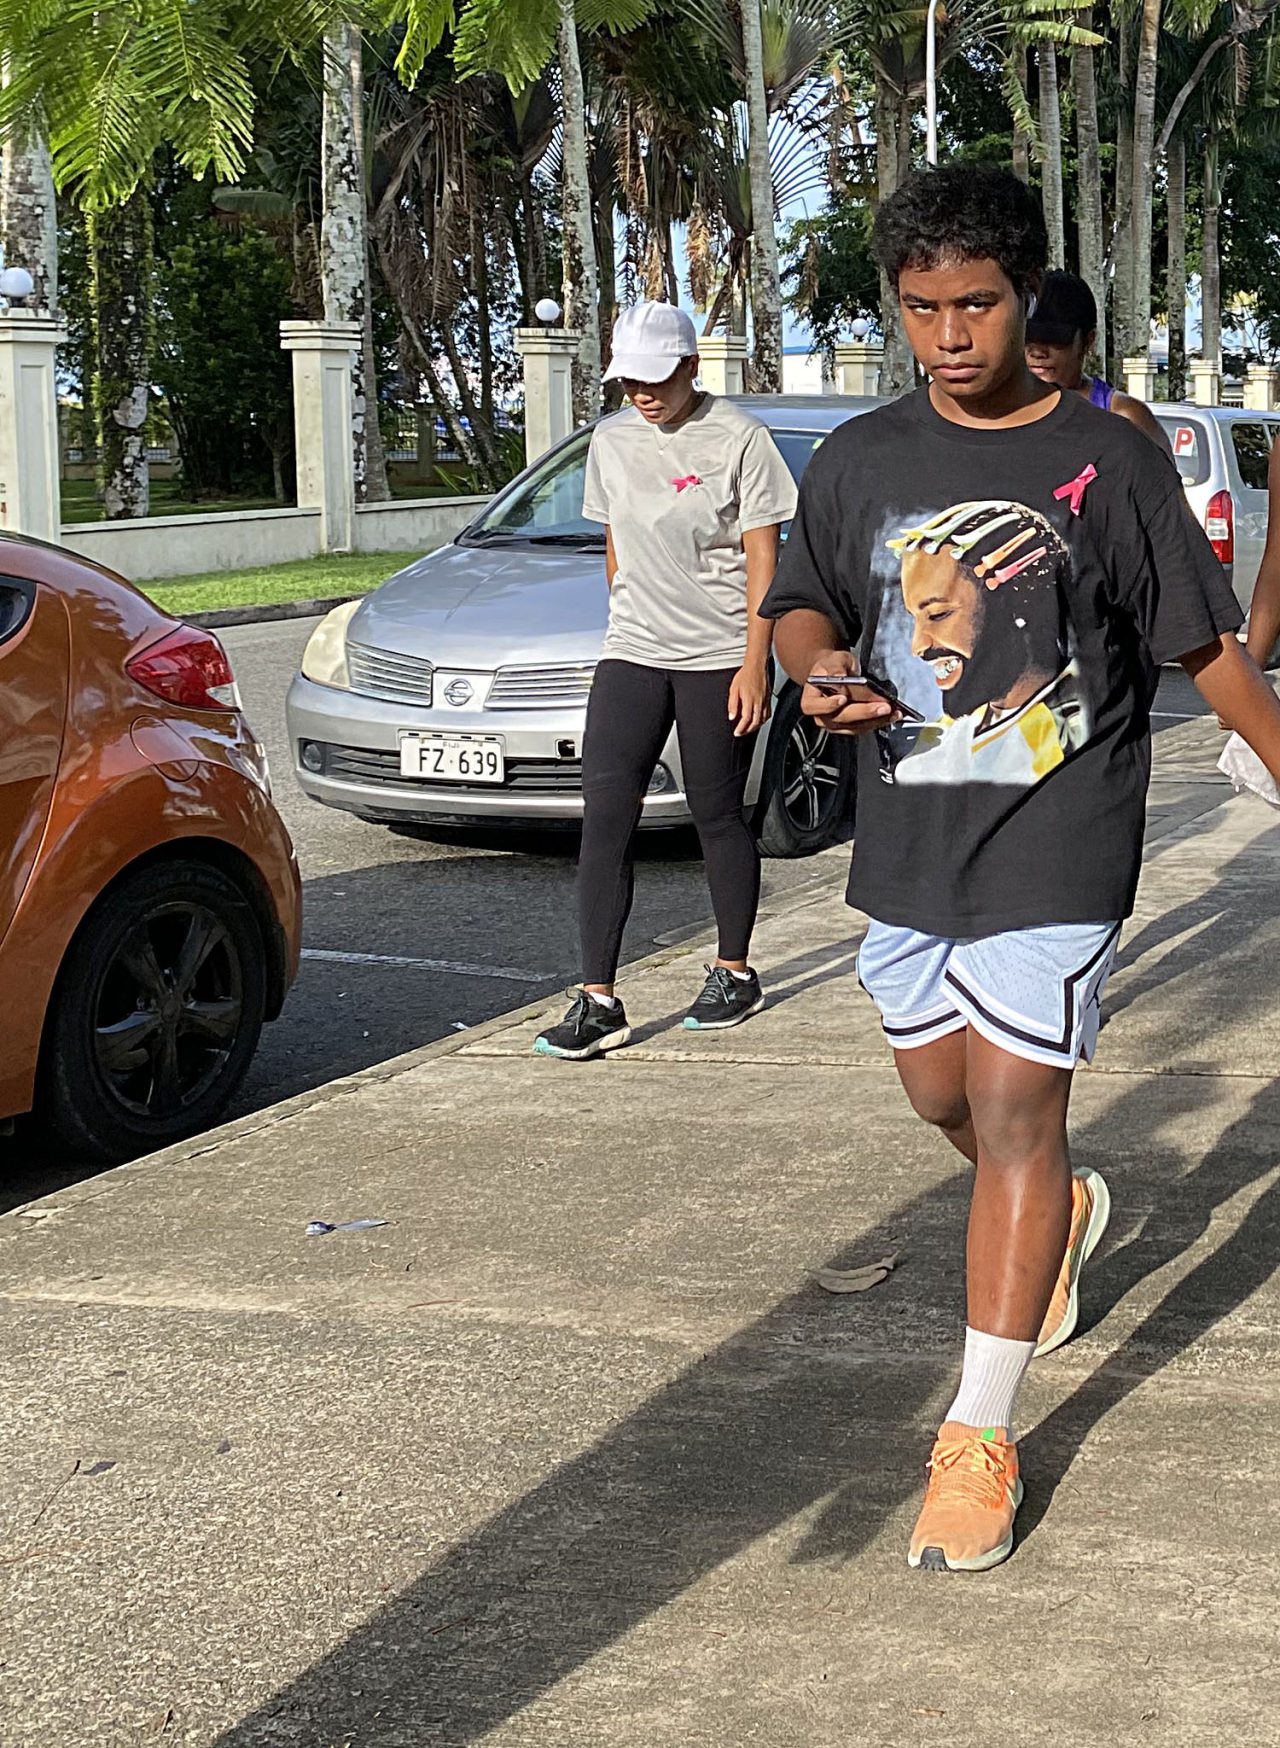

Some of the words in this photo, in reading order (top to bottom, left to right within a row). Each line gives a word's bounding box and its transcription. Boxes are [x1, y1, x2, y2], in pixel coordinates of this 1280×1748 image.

[1175, 429, 1194, 454] P
[418, 747, 445, 773] FZ
[458, 750, 498, 776] 639
